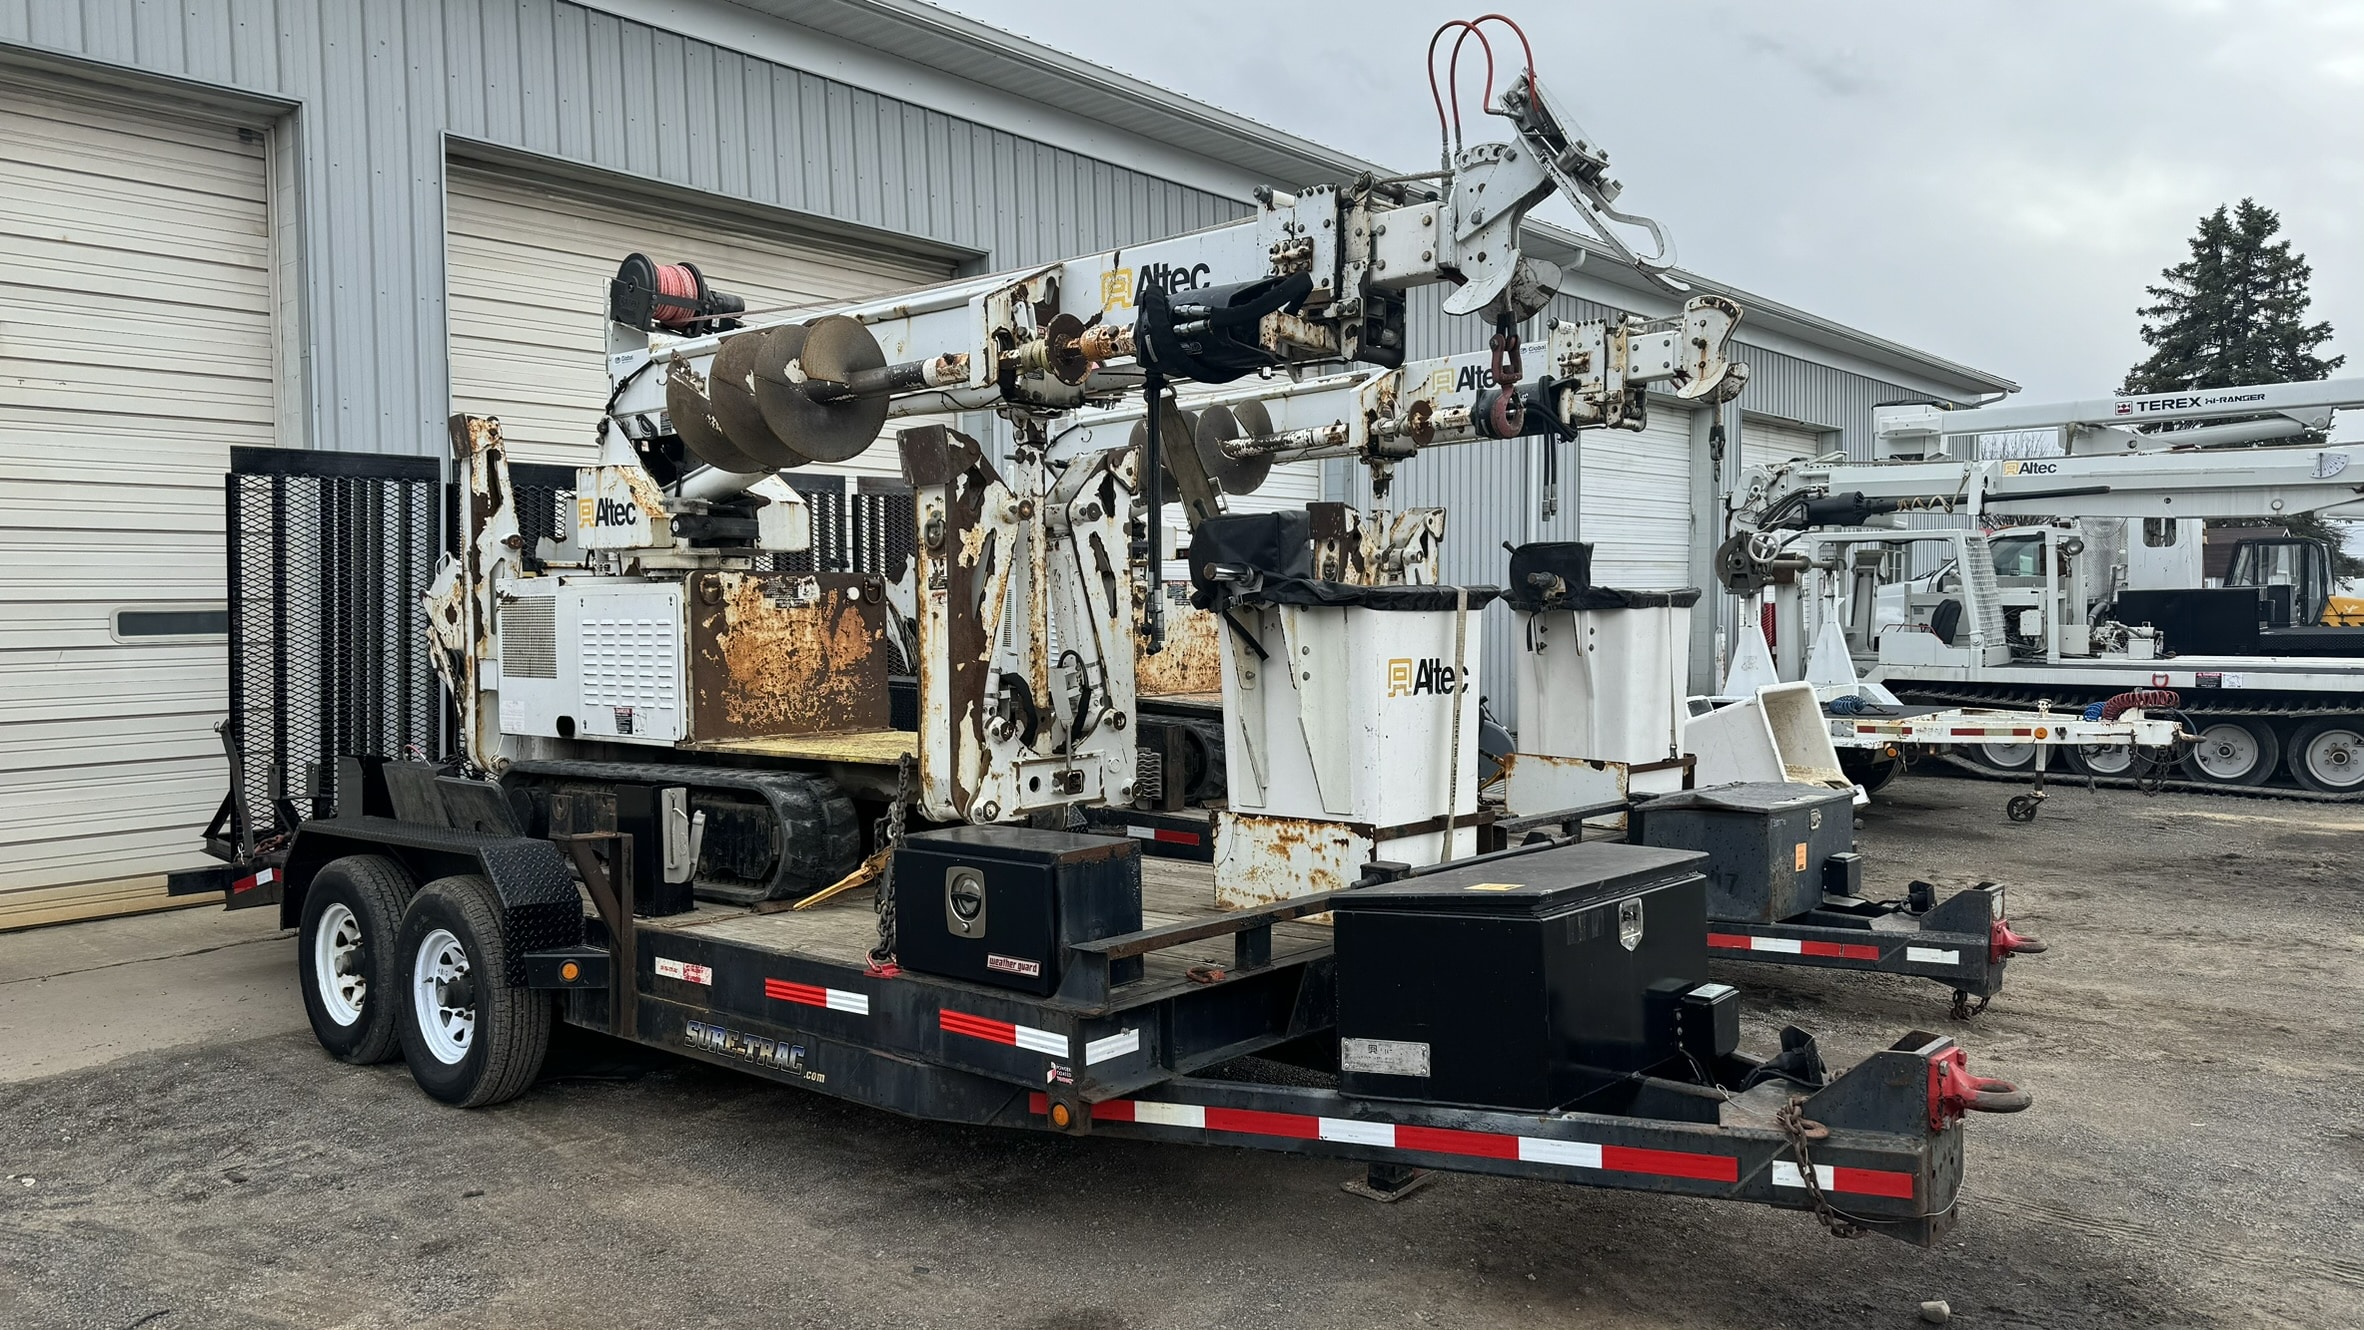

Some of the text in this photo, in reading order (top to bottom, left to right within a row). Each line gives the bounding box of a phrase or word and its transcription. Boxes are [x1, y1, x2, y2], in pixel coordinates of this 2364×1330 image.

[1133, 262, 1211, 306] Altec
[1455, 365, 1497, 393] Alte
[2137, 397, 2202, 411] TEREX
[2018, 461, 2057, 475] Altec
[595, 497, 637, 527] Altec
[989, 957, 1038, 973] weather guard
